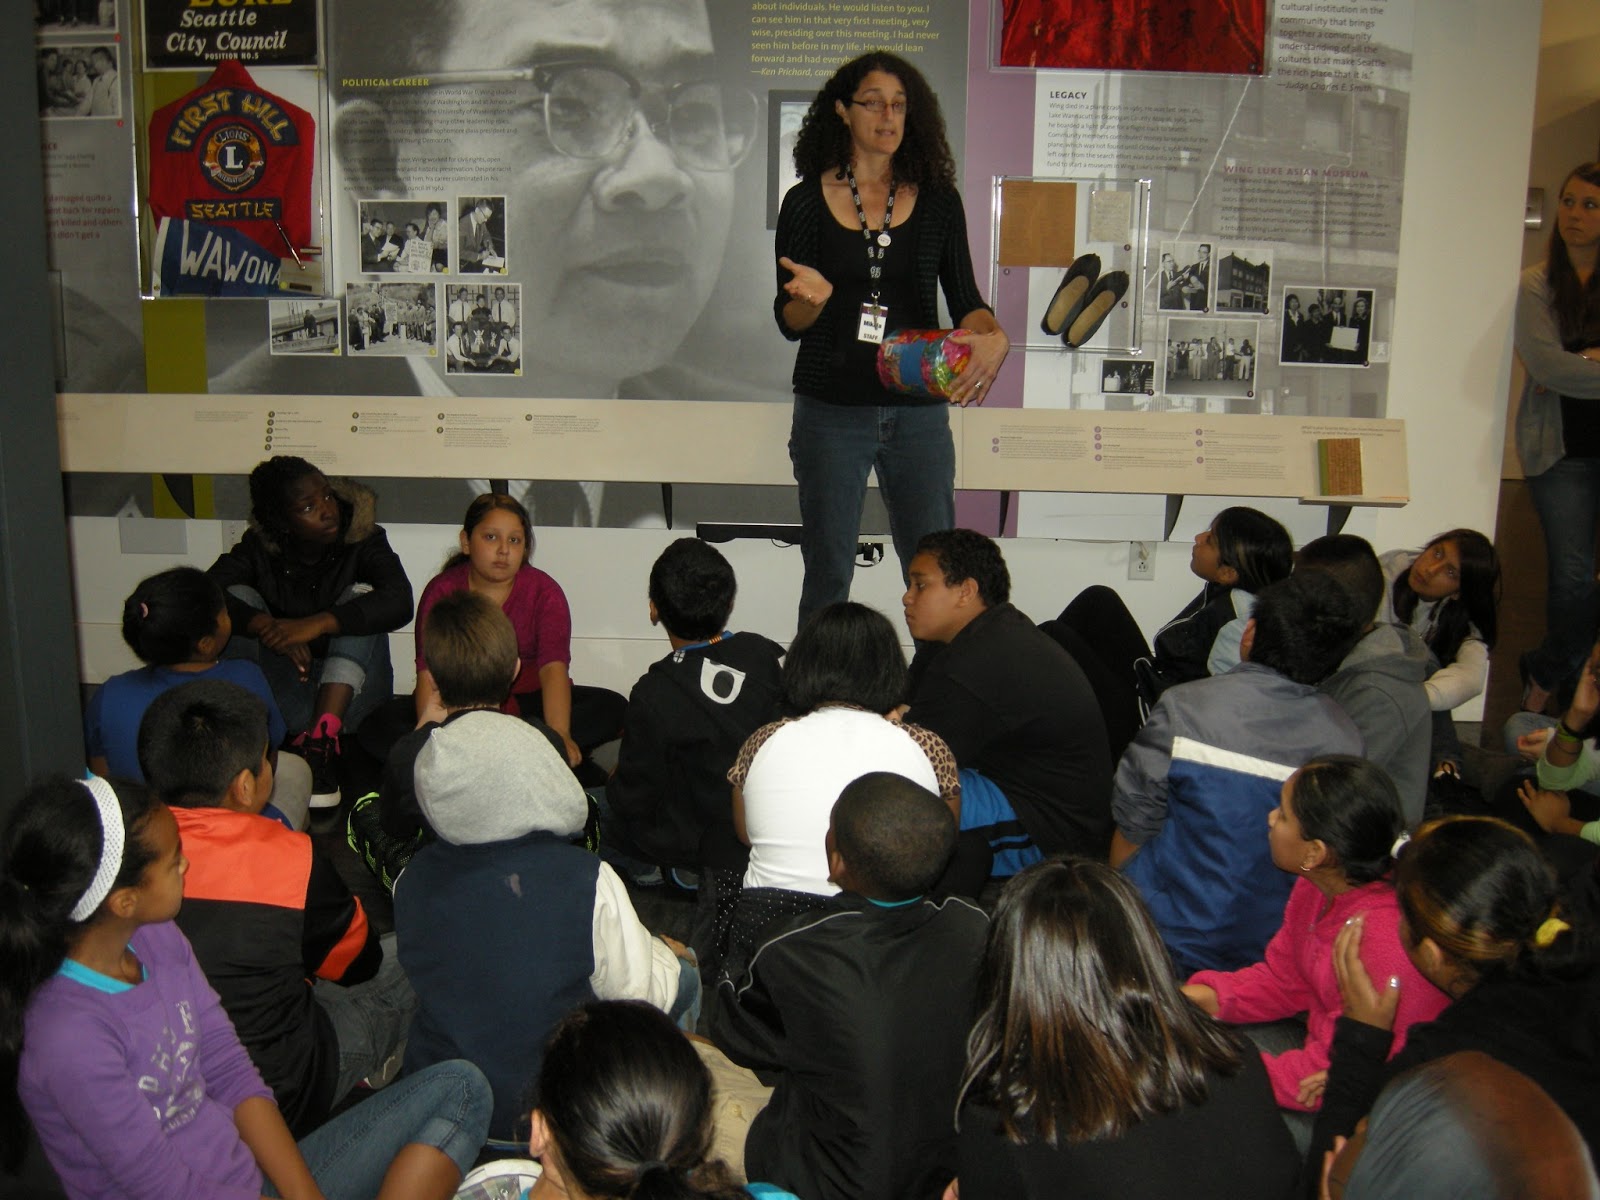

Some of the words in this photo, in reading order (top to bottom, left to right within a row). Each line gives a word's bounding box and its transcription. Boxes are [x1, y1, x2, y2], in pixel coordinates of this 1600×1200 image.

[752, 2, 776, 10] about
[779, 2, 828, 11] individuals.
[829, 3, 841, 11] He
[843, 4, 869, 12] would
[871, 4, 895, 12] listen
[896, 4, 906, 12] to
[906, 6, 925, 14] you.
[926, 5, 930, 13] I
[1280, 3, 1312, 11] cultural
[1314, 4, 1358, 14] institution
[1360, 6, 1368, 14] in
[1370, 6, 1384, 14] the
[180, 9, 257, 28] Seattle
[784, 15, 802, 24] him
[803, 15, 812, 24] in
[814, 16, 832, 24] that
[834, 18, 852, 26] very
[854, 16, 870, 25] first
[872, 16, 911, 28] meeting,
[912, 19, 930, 28] very
[1280, 16, 1328, 26] community
[1330, 17, 1347, 26] that
[1350, 18, 1376, 29] brings
[752, 28, 774, 38] wise,
[774, 28, 814, 39] presiding
[836, 30, 852, 38] this
[854, 30, 892, 40] meeting.
[898, 30, 915, 39] had
[1279, 28, 1316, 39] together
[1324, 31, 1372, 42] community
[166, 32, 207, 56] City
[216, 30, 288, 50] Council
[773, 41, 790, 50] him
[792, 41, 819, 50] before
[820, 42, 830, 50] in
[832, 44, 845, 53] my
[846, 42, 862, 52] life.
[863, 43, 875, 52] He
[905, 44, 924, 52] lean
[1279, 42, 1340, 53] understanding
[1342, 44, 1350, 52] of
[1364, 46, 1378, 54] the
[205, 52, 239, 60] POSITION
[752, 54, 786, 63] forward
[787, 54, 803, 63] and
[804, 54, 821, 63] had
[1278, 54, 1312, 64] cultures
[1314, 56, 1330, 64] that
[1333, 57, 1356, 66] make
[1358, 58, 1386, 67] Seattle
[342, 78, 390, 87] POLITICAL
[392, 78, 430, 86] CAREER
[1050, 90, 1088, 100] LEGACY
[171, 90, 233, 147] FIRST
[242, 94, 289, 140] HILL
[219, 130, 250, 142] LIONS
[225, 146, 244, 168] L
[1258, 166, 1283, 174] LUKE
[1286, 168, 1318, 176] ASIAN
[1322, 169, 1369, 178] MUSEUM
[191, 202, 274, 219] SEATTLE
[180, 220, 280, 285] WAWONA
